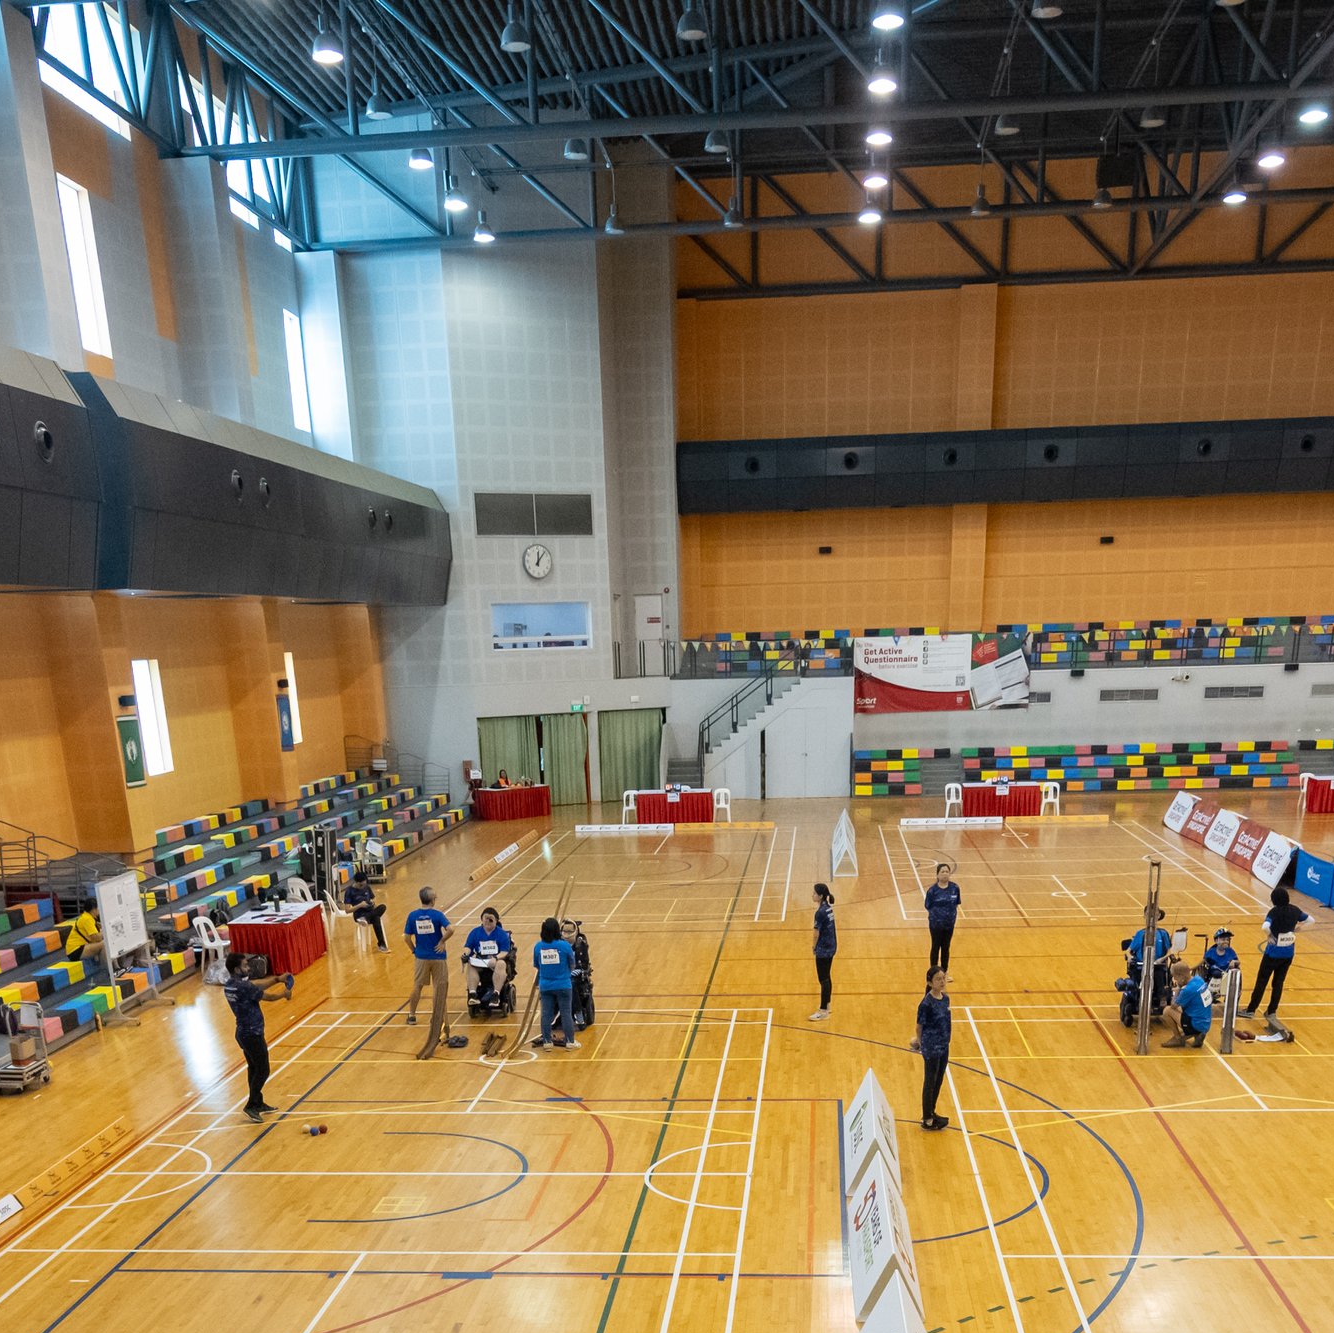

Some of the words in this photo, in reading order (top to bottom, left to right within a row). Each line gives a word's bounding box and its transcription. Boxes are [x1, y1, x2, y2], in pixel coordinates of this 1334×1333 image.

[864, 648, 877, 656] Get
[878, 647, 903, 655] Active
[864, 655, 918, 664] Questionnaire
